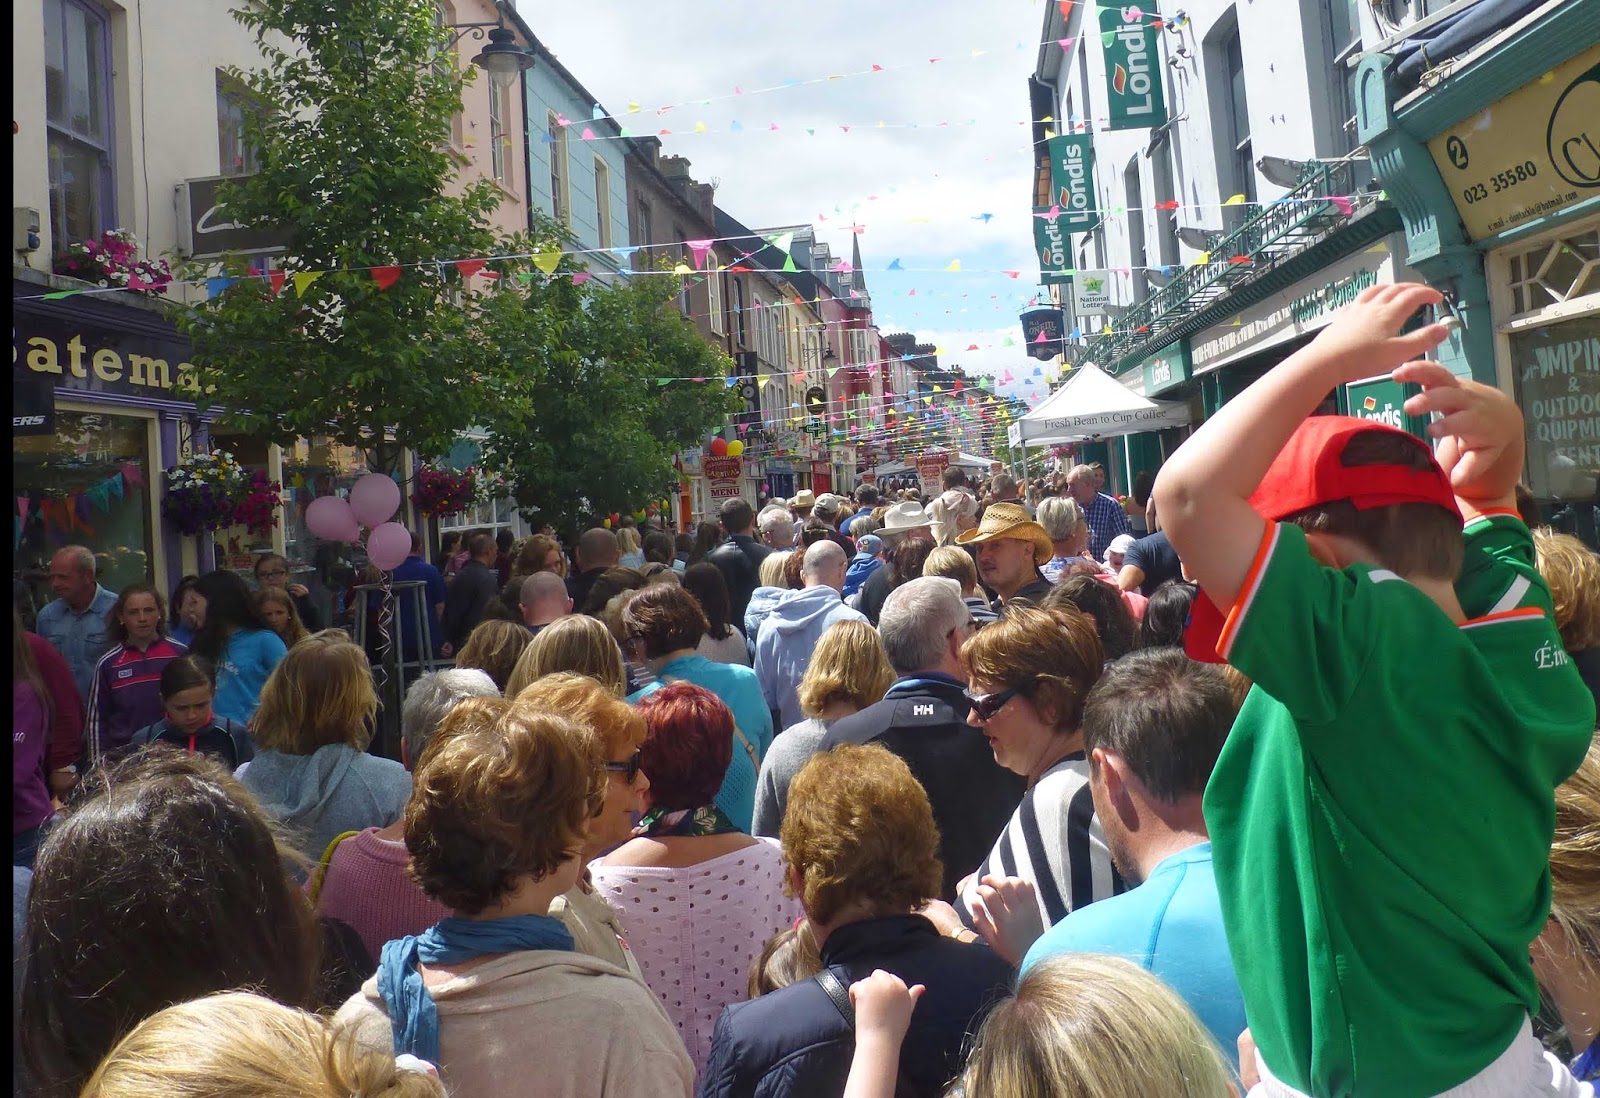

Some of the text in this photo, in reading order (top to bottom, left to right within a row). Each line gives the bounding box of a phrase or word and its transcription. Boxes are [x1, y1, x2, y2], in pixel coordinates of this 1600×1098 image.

[1117, 5, 1152, 115] Londis
[1448, 139, 1467, 167] 2
[1063, 144, 1089, 223] Londis
[1464, 161, 1537, 204] 023 35580
[1080, 295, 1109, 303] National
[13, 326, 223, 395] atema
[1568, 376, 1580, 392] &
[1044, 409, 1167, 429] Fresh Bean to Cup Coffee
[711, 488, 740, 497] MENU
[1535, 640, 1568, 669] Éin
[914, 704, 933, 715] HH
